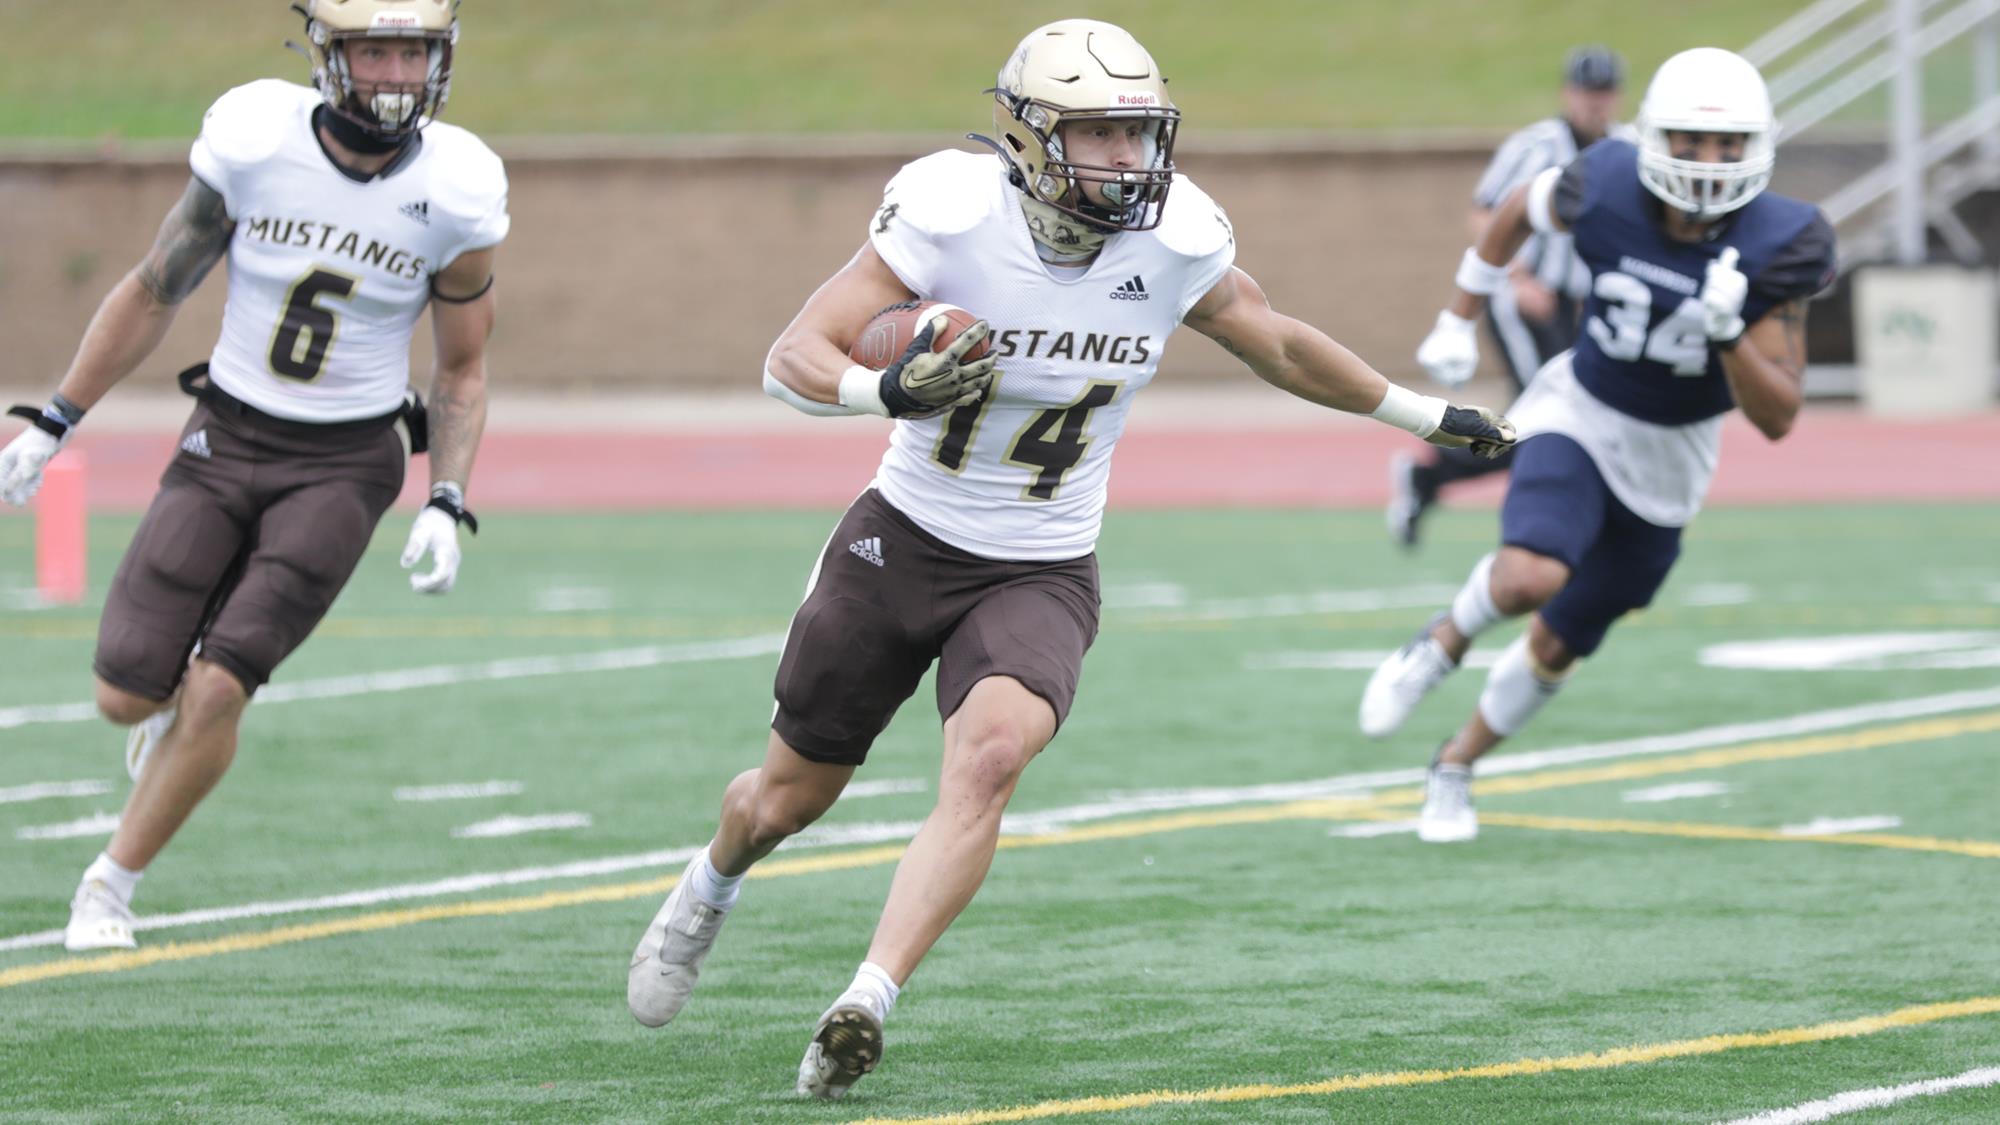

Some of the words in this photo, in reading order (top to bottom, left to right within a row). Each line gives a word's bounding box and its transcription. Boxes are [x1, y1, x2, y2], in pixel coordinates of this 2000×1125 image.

[1117, 94, 1156, 105] Riddell
[246, 216, 426, 280] MUSTANGS
[1109, 290, 1150, 301] adidas
[265, 262, 363, 385] 6
[987, 329, 1151, 365] STANGS
[1586, 271, 1708, 378] 34
[931, 368, 1126, 501] 14
[848, 543, 885, 567] adidas
